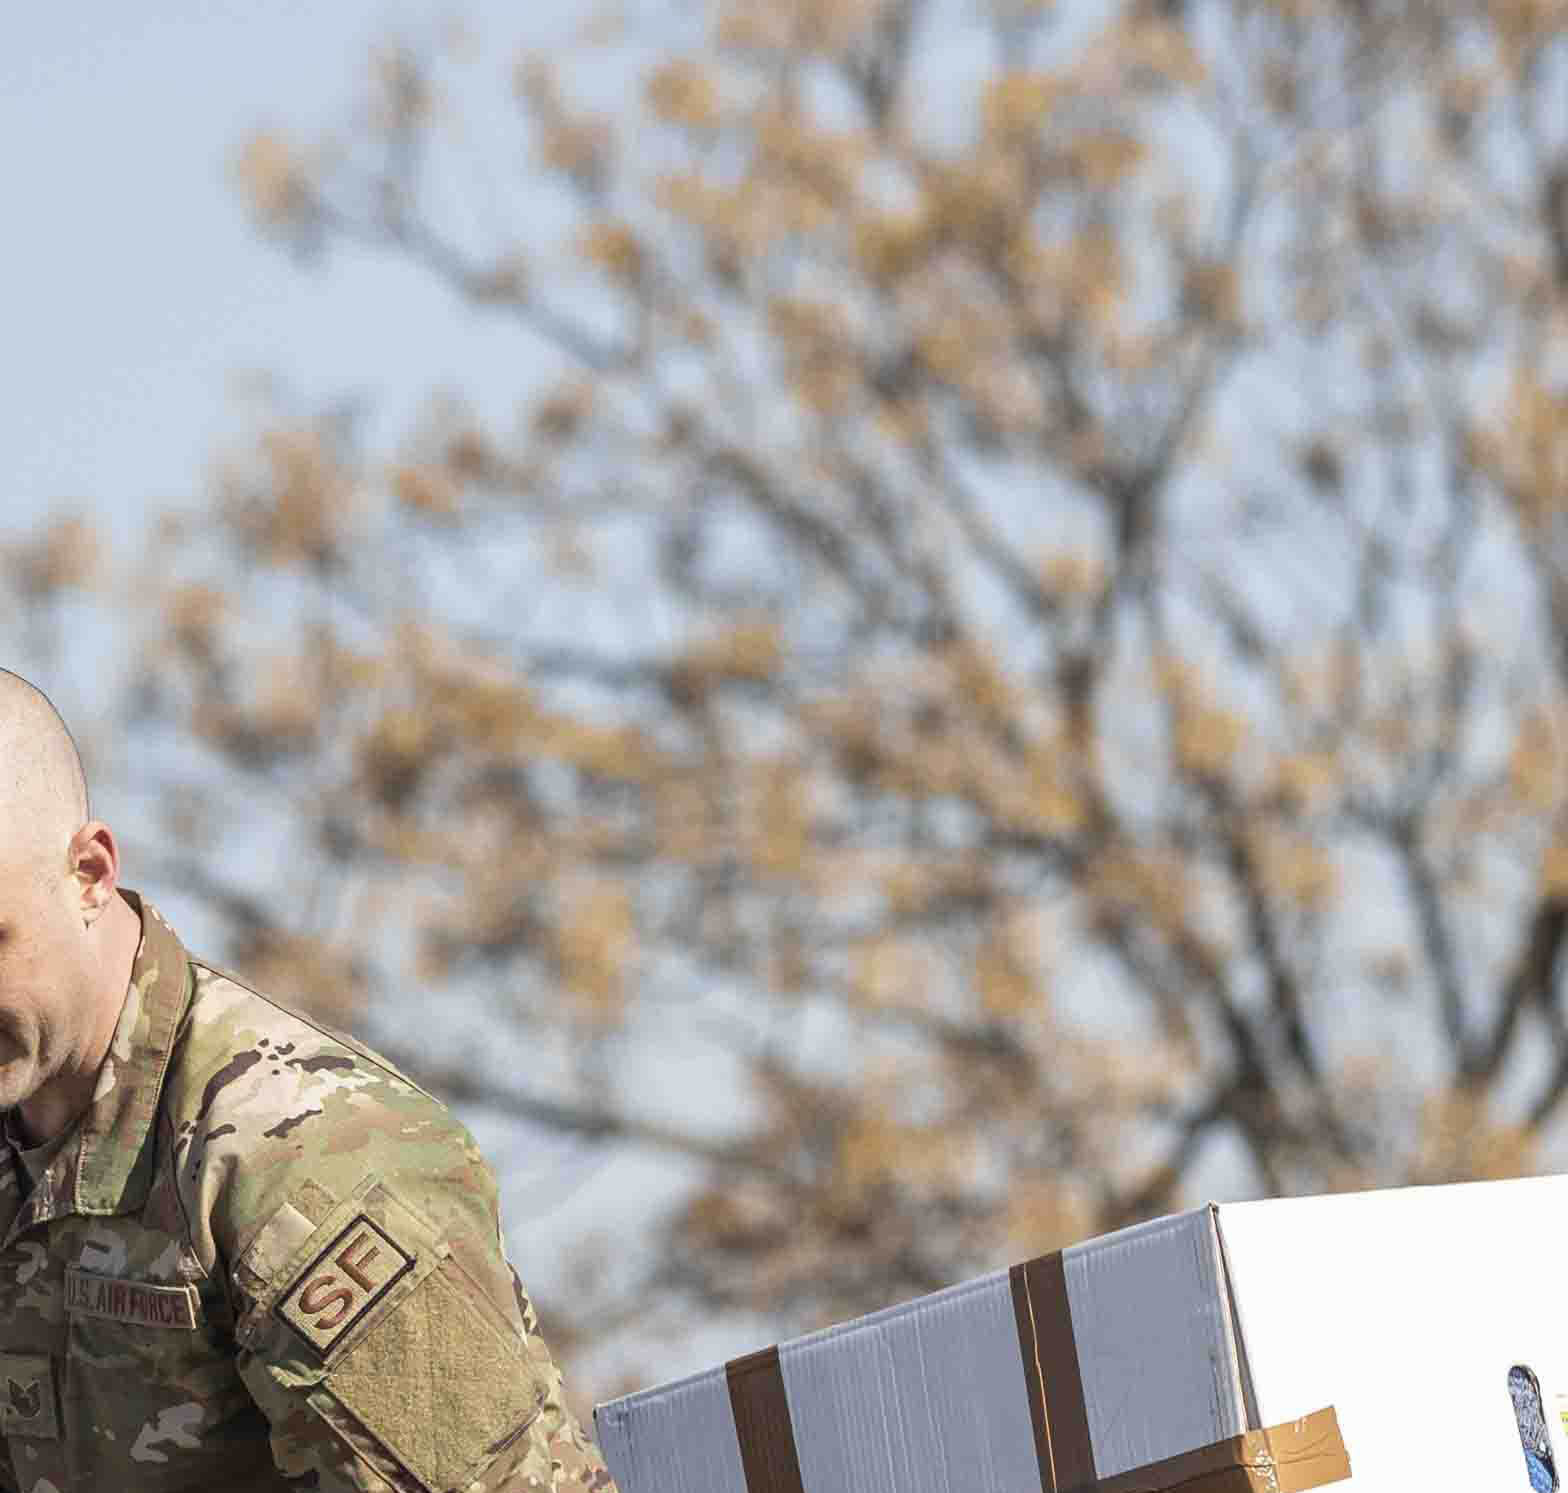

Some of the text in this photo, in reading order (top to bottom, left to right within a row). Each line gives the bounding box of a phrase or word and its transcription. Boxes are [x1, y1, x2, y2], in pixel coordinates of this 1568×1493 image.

[95, 1283, 128, 1315] AIR
[129, 1290, 185, 1325] FORCE
[299, 1232, 383, 1331] SF
